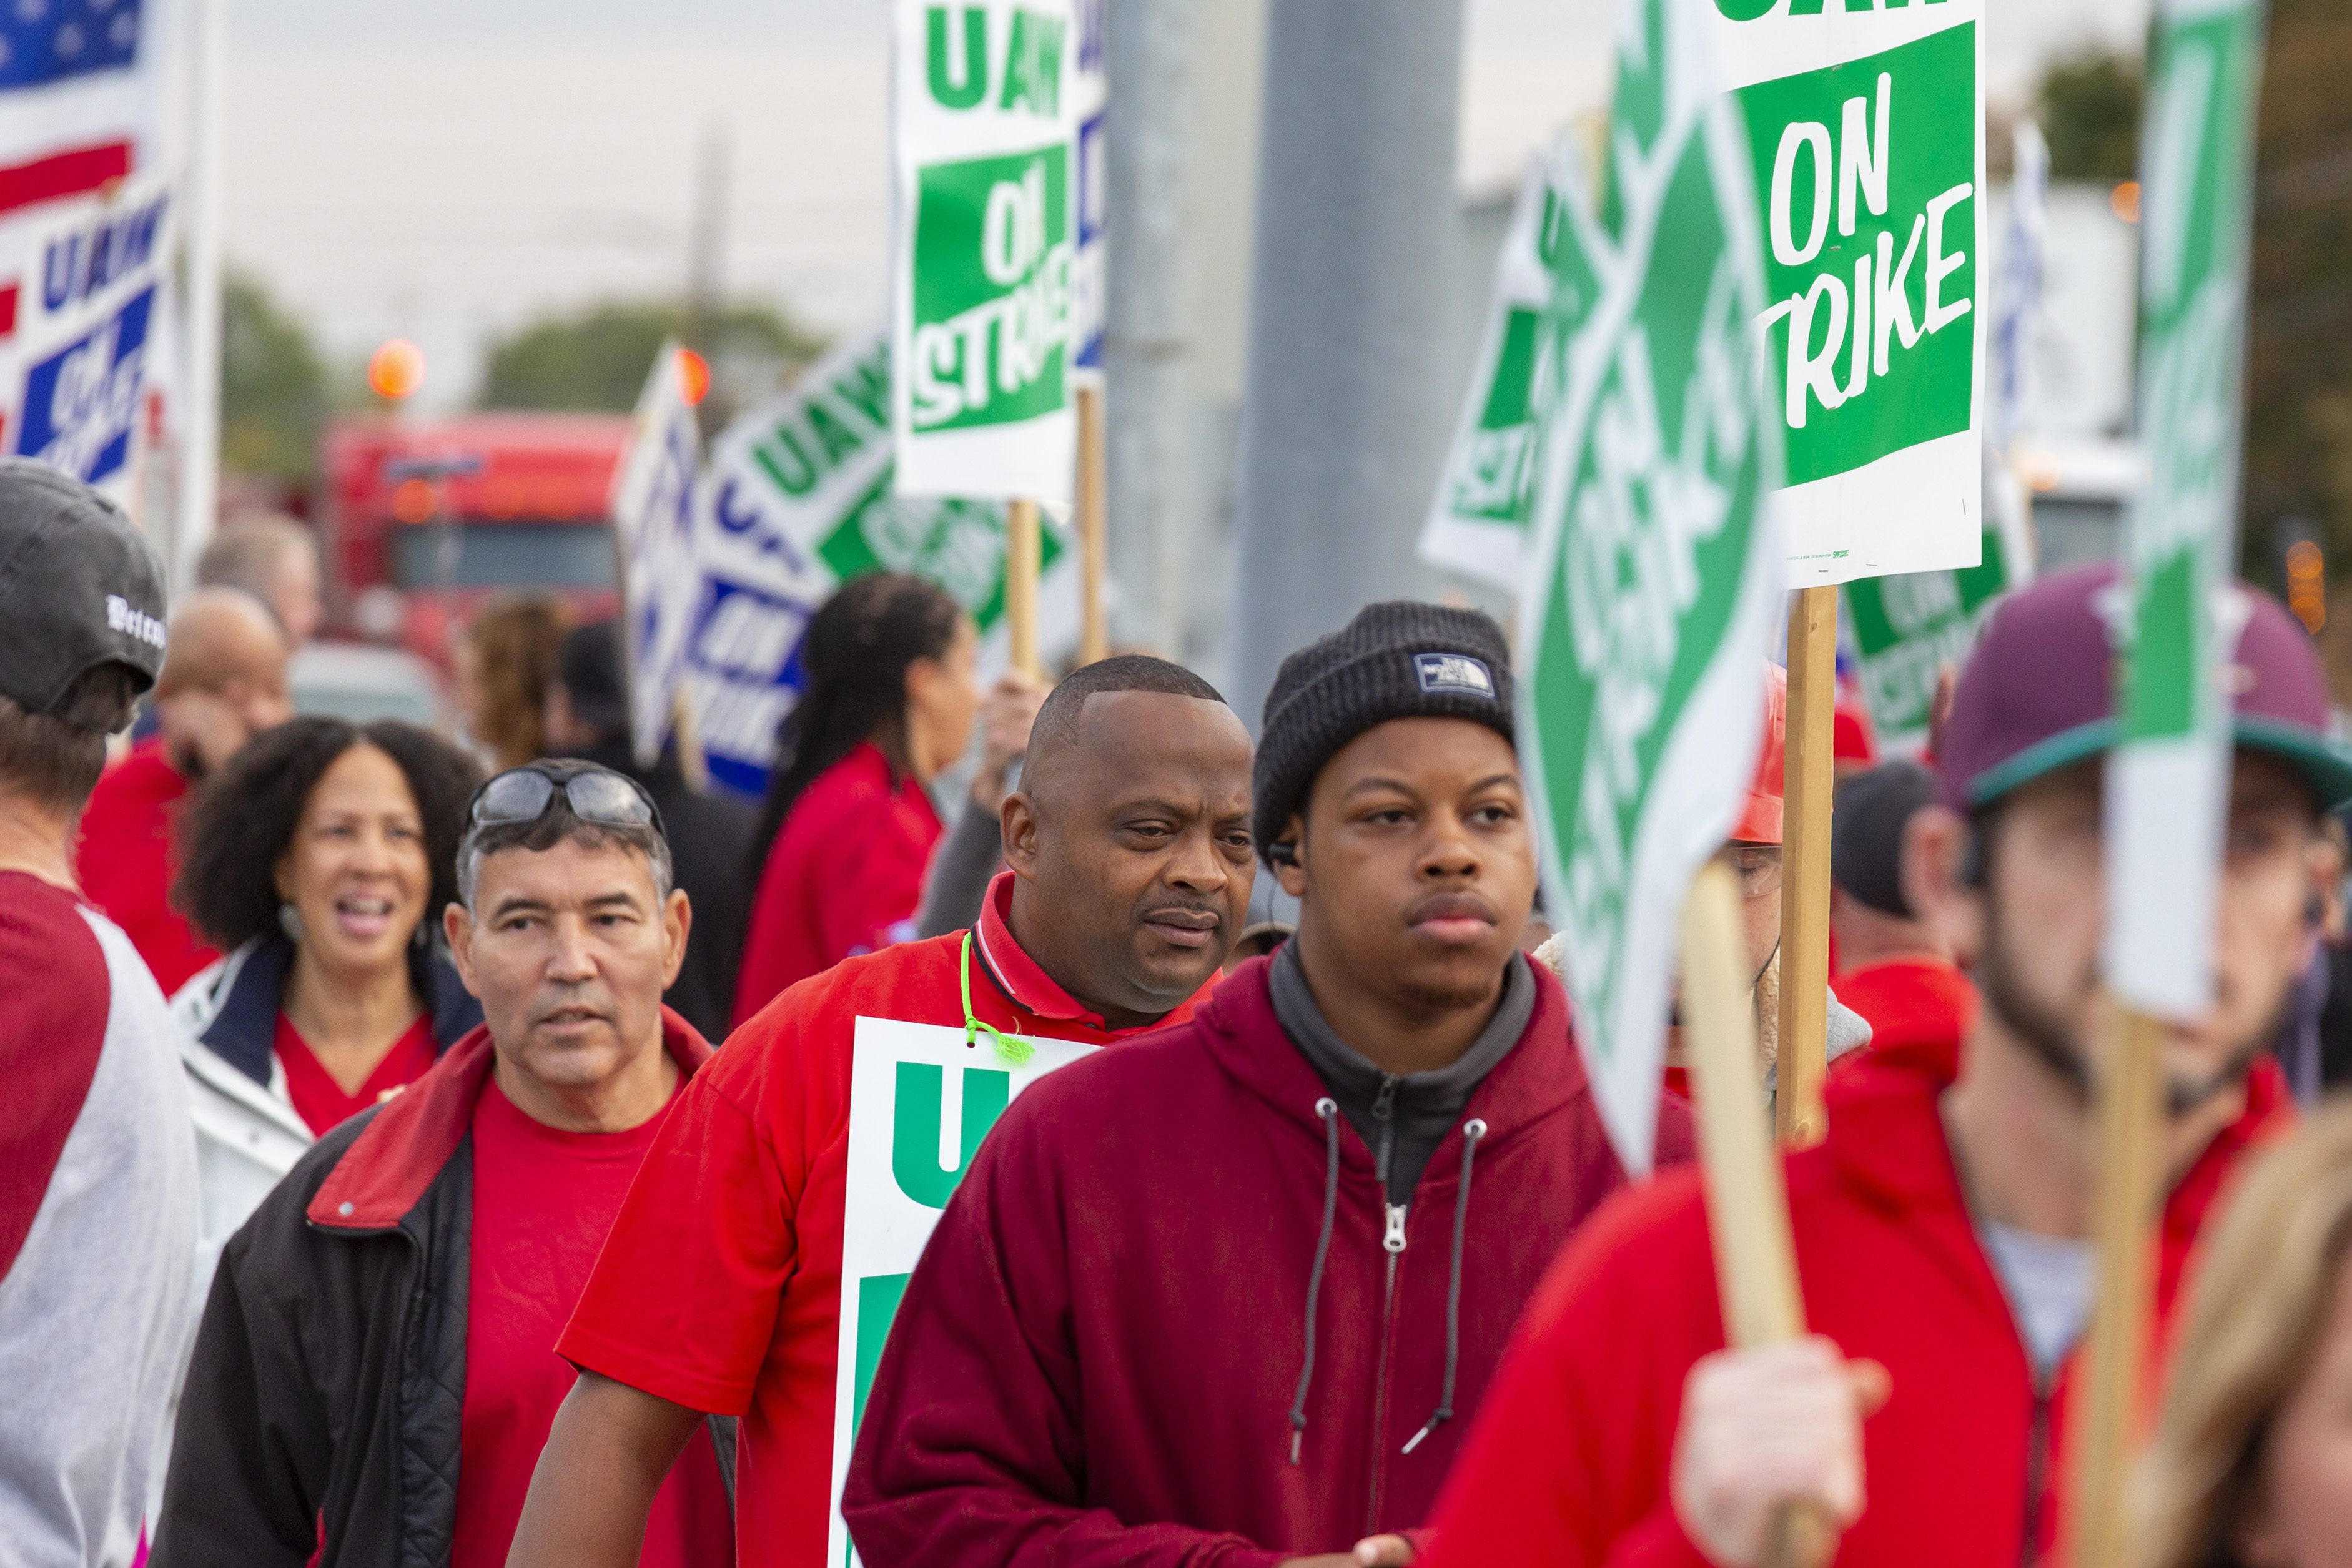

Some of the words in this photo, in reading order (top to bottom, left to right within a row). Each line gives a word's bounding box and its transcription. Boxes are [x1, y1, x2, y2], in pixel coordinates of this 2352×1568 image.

[1770, 72, 1891, 266] ON
[1751, 182, 1974, 428] TRIKE
[107, 594, 166, 649] Detro
